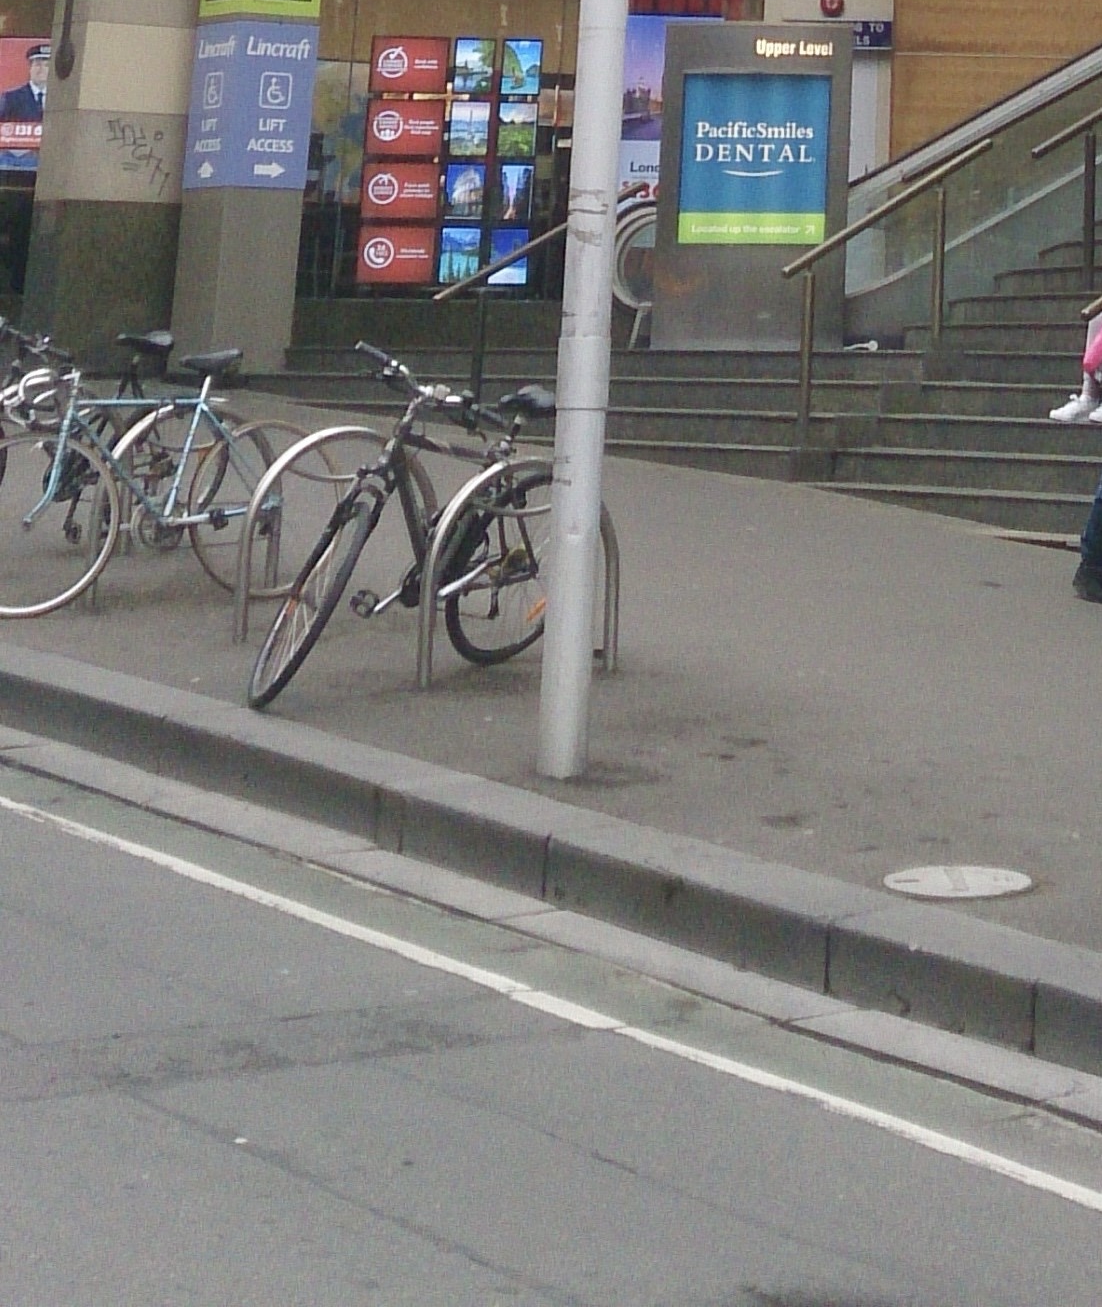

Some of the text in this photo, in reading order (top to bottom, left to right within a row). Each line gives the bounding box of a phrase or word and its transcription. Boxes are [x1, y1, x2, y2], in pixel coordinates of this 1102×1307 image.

[198, 35, 236, 59] Lincraft
[247, 36, 310, 60] Lincraft
[755, 38, 833, 58] Upper Level
[258, 118, 287, 131] LIFT
[696, 121, 814, 139] PacificSmiles
[247, 138, 294, 153] ACCESS
[694, 143, 813, 163] DENTAL
